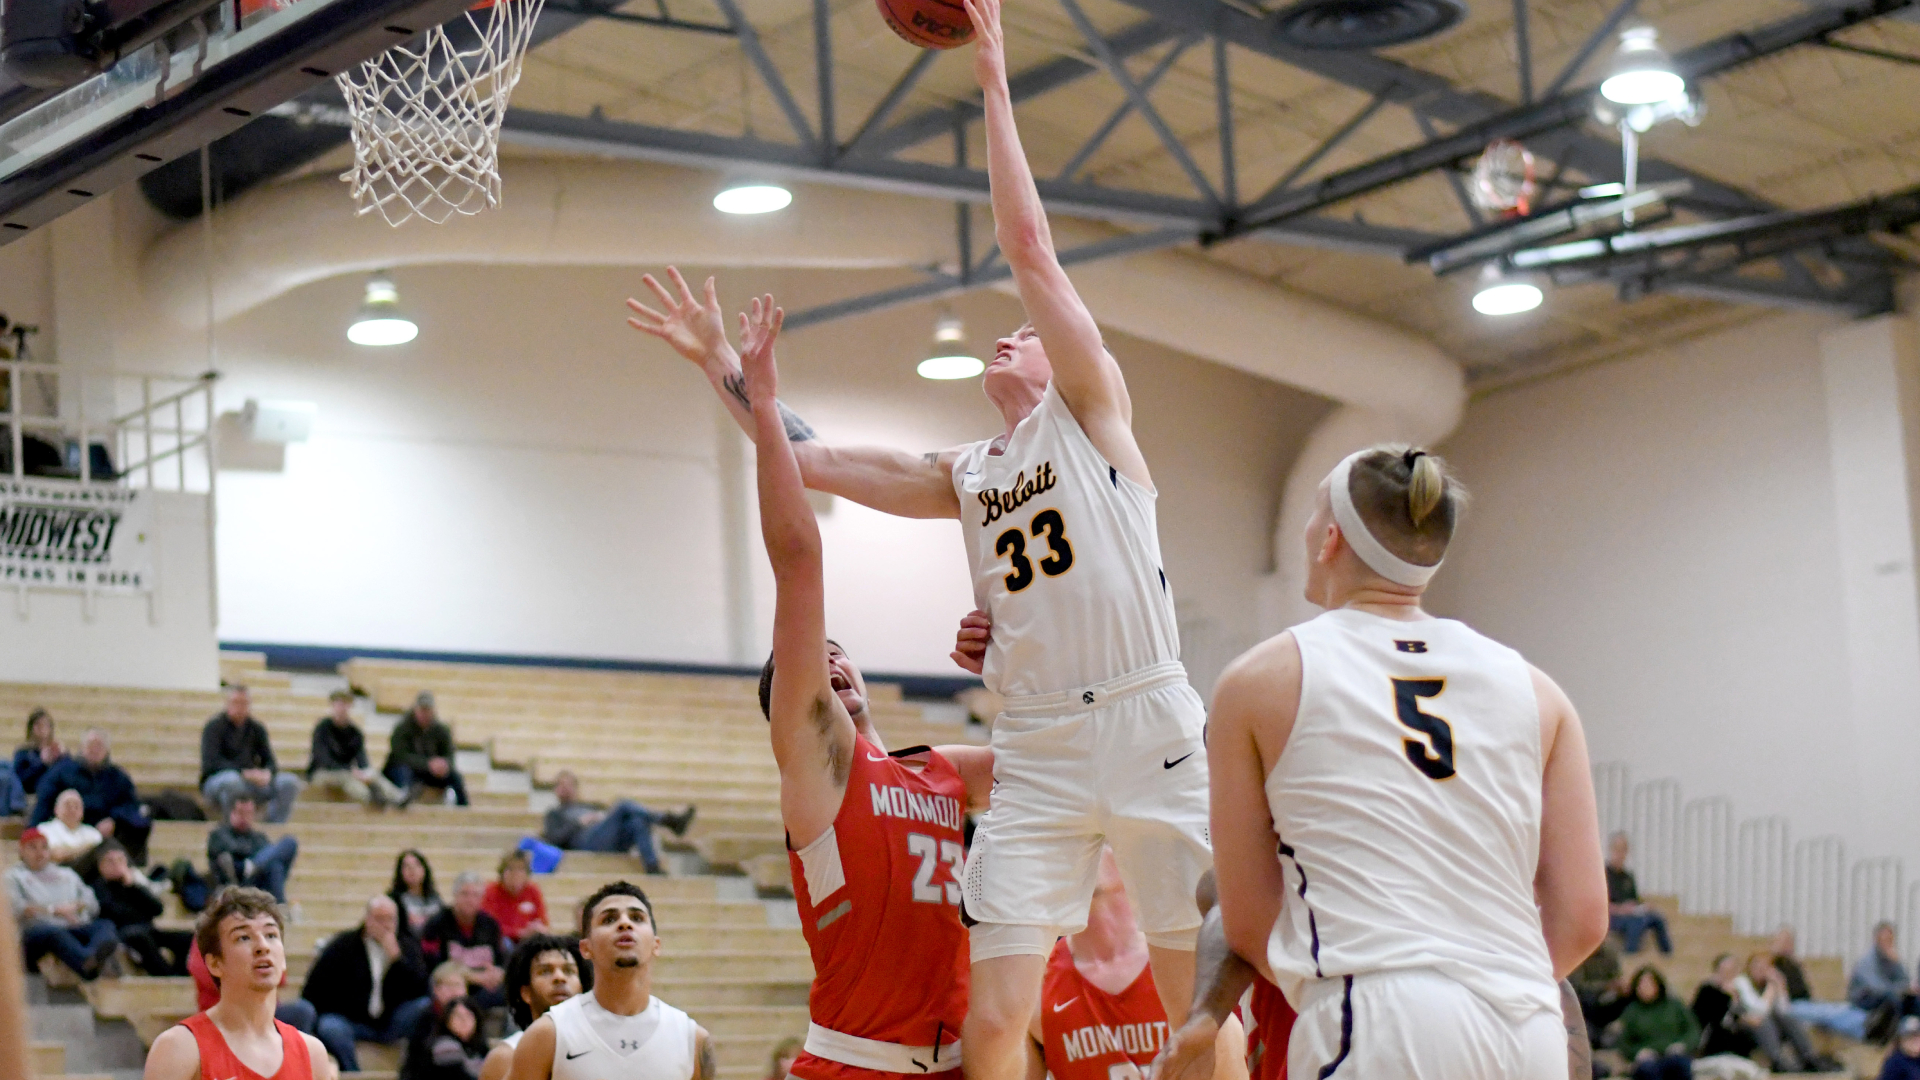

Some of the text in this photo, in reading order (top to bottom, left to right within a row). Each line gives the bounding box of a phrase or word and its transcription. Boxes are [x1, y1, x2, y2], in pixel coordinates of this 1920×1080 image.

[0, 506, 121, 552] MIDWEST
[977, 460, 1057, 527] Beloit
[994, 506, 1076, 595] 33
[1392, 639, 1429, 654] B
[1387, 674, 1457, 782] 5
[907, 831, 966, 907] 23
